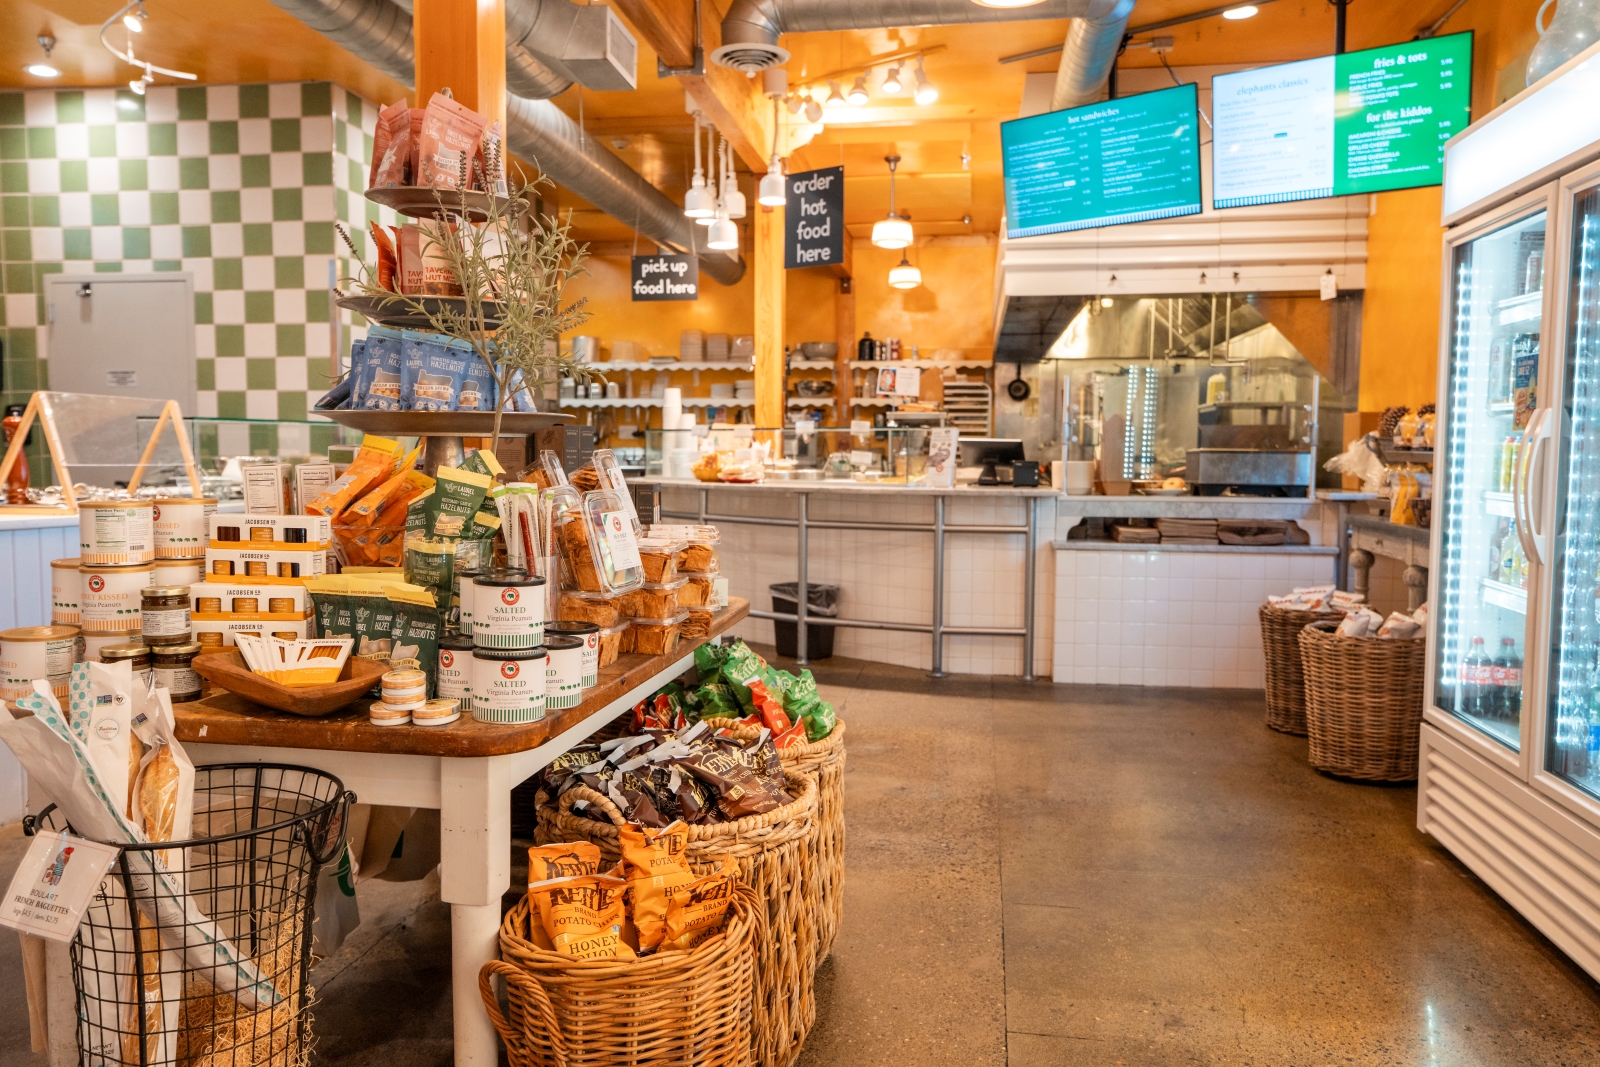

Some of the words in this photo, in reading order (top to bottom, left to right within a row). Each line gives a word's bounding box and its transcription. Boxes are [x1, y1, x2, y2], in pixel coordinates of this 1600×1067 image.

[1374, 57, 1395, 69] fries
[1396, 54, 1406, 66] &
[1408, 52, 1428, 63] tots
[1236, 83, 1276, 98] elephants
[1277, 77, 1309, 91] classics
[1068, 115, 1080, 125] hot
[1081, 109, 1119, 121] sandwiches
[1366, 112, 1381, 123] for
[1382, 109, 1399, 121] the
[1400, 105, 1433, 119] kiddos
[793, 174, 834, 195] order
[801, 198, 828, 217] hot
[796, 217, 831, 242] food
[797, 243, 832, 264] here
[425, 266, 453, 277] TAVERN
[642, 258, 670, 278] pick
[670, 261, 689, 278] up
[407, 278, 422, 286] NUT
[425, 274, 441, 282] NUT
[632, 279, 663, 295] food
[665, 278, 696, 295] here
[406, 360, 424, 369] LAUREL
[430, 361, 465, 379] HAZELNUTS
[457, 485, 475, 496] LAUREL
[440, 502, 471, 514] HAZELNUTS
[98, 594, 129, 602] KISSED
[227, 589, 254, 597] JACOBSEN
[98, 602, 122, 610] Peanuts
[494, 606, 526, 615] SALTED
[487, 614, 510, 623] Virginia
[511, 614, 533, 622] Peanuts
[447, 679, 469, 687] Peanuts
[494, 680, 526, 689] SALTED
[486, 688, 511, 698] Virginia
[512, 688, 534, 696] Peanuts
[30, 888, 59, 902] BOULART
[549, 881, 616, 912] KETTLE
[13, 895, 36, 907] FRENCH
[36, 901, 69, 915] BAGUETTES
[574, 906, 597, 918] BRAND
[703, 899, 728, 913] BRAND
[552, 917, 591, 928] POTATO
[592, 913, 620, 928] CHIPS
[683, 912, 717, 930] POTATO
[689, 925, 724, 949] HONEY
[569, 934, 618, 955] HONEY
